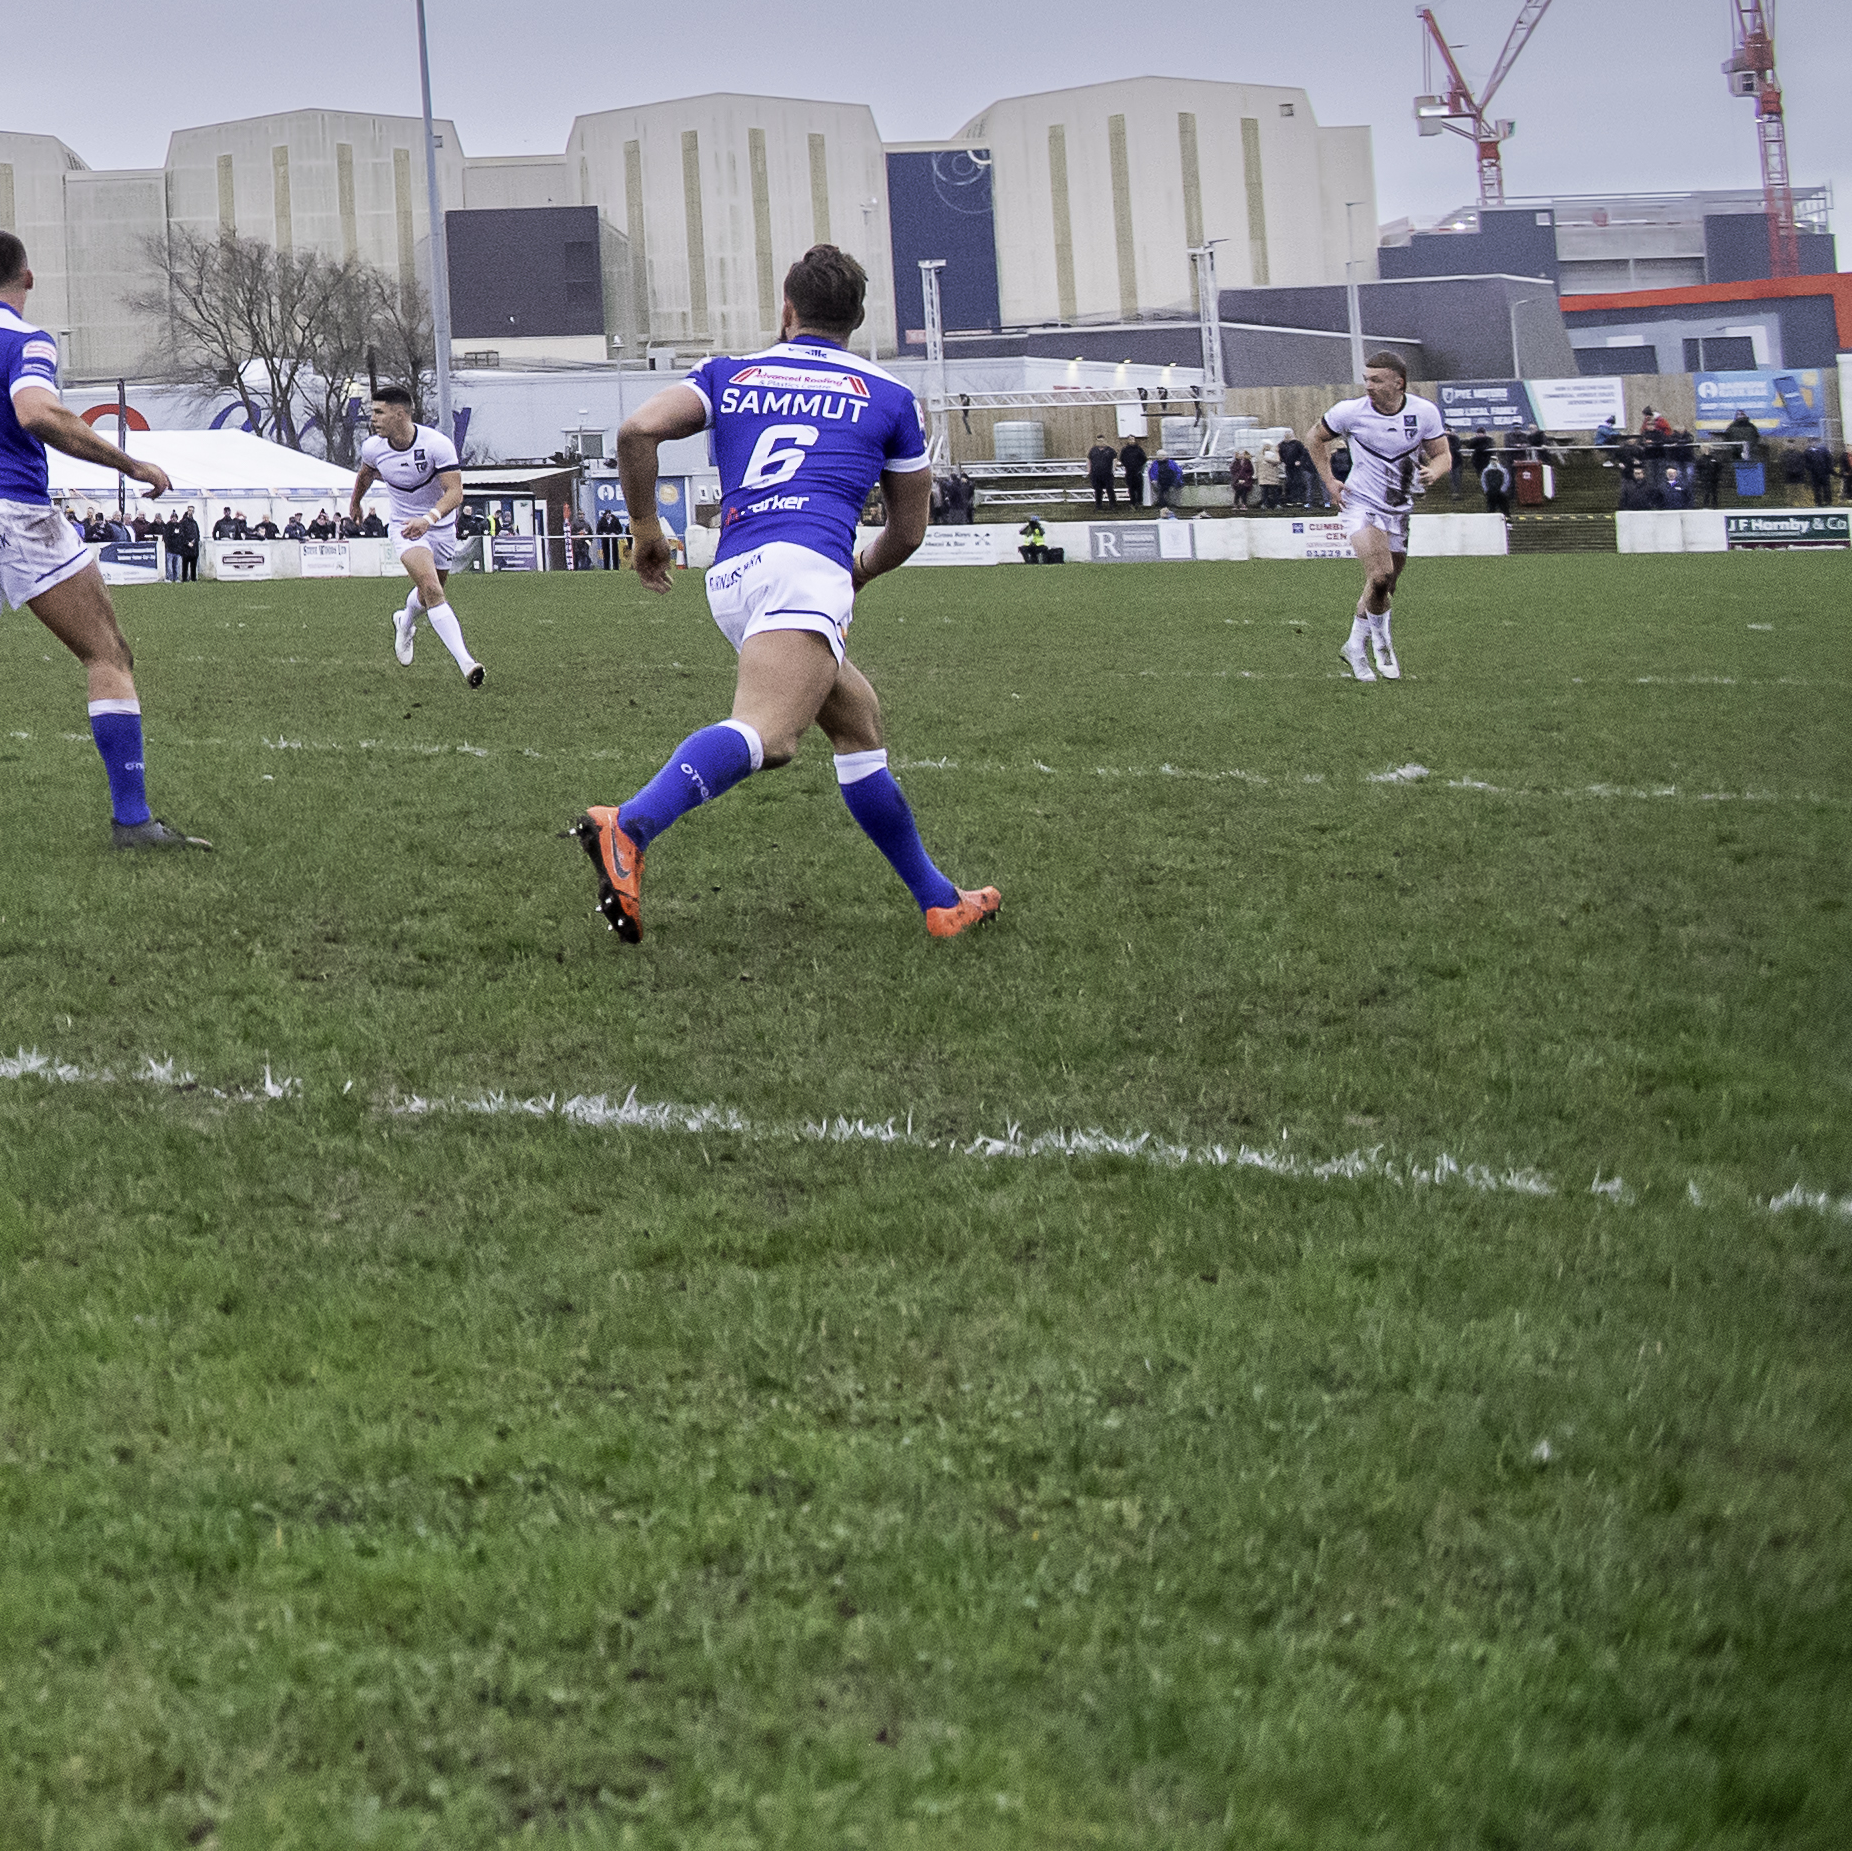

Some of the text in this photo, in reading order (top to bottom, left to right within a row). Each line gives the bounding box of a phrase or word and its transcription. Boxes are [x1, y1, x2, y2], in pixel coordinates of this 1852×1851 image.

[804, 376, 843, 387] Roofing
[721, 388, 869, 423] SAMMUT
[739, 424, 819, 490] 6
[1751, 517, 1811, 534] Hornby
[1812, 518, 1825, 530] &
[1826, 517, 1847, 530] Co
